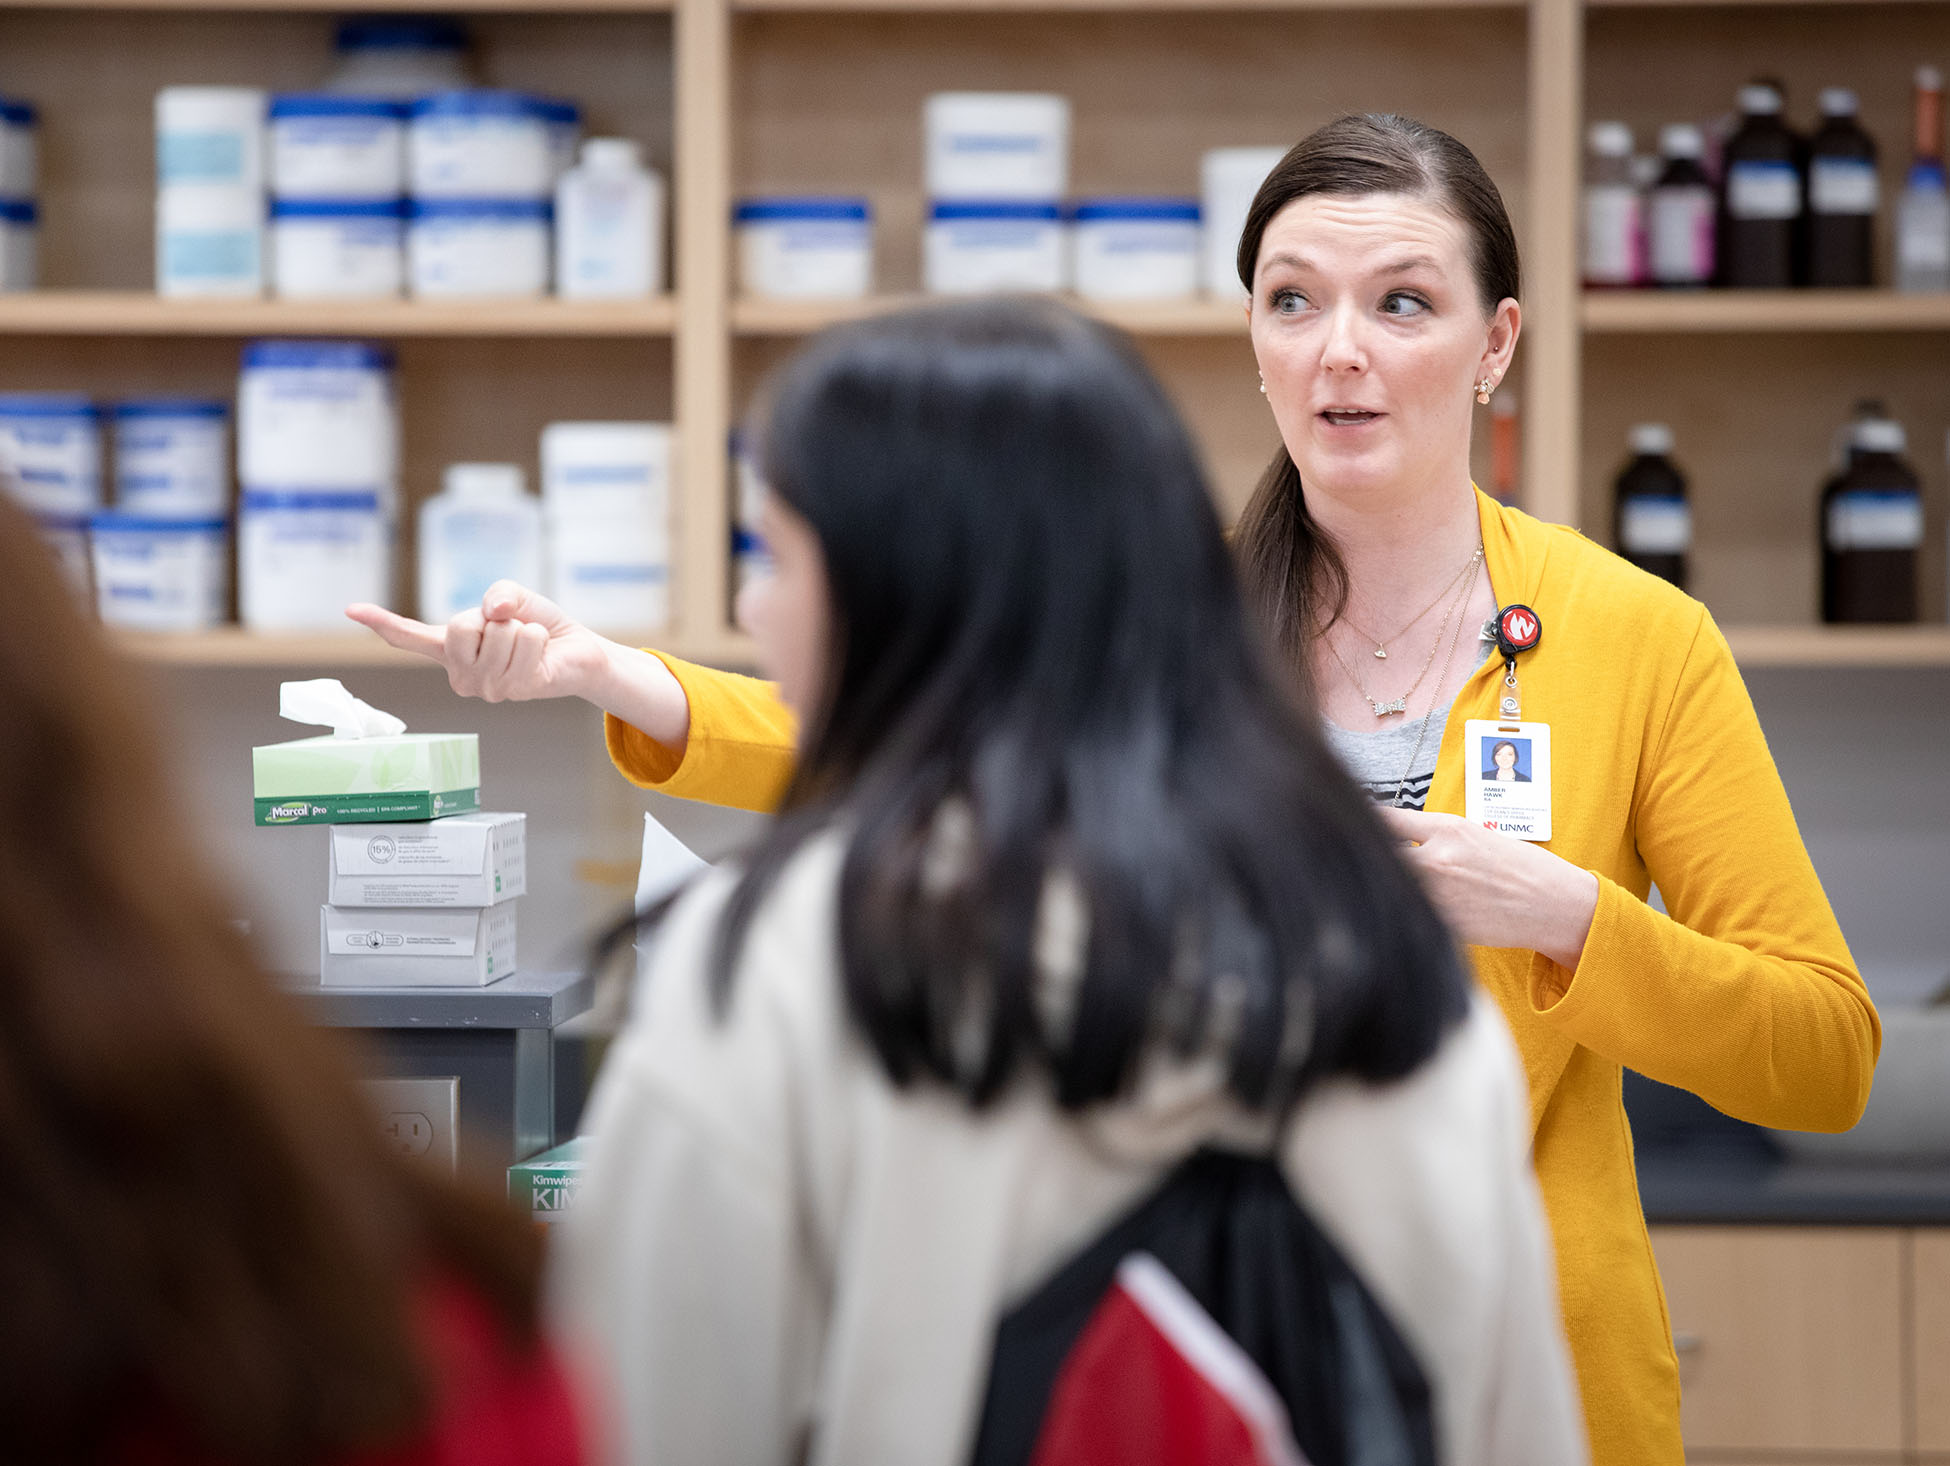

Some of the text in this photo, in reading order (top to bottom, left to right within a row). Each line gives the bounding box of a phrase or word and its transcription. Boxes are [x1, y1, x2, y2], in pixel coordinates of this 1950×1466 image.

[272, 804, 308, 818] Marcal
[1500, 823, 1534, 833] UNMC
[372, 845, 391, 854] 15%
[533, 1175, 582, 1187] Kimwipe
